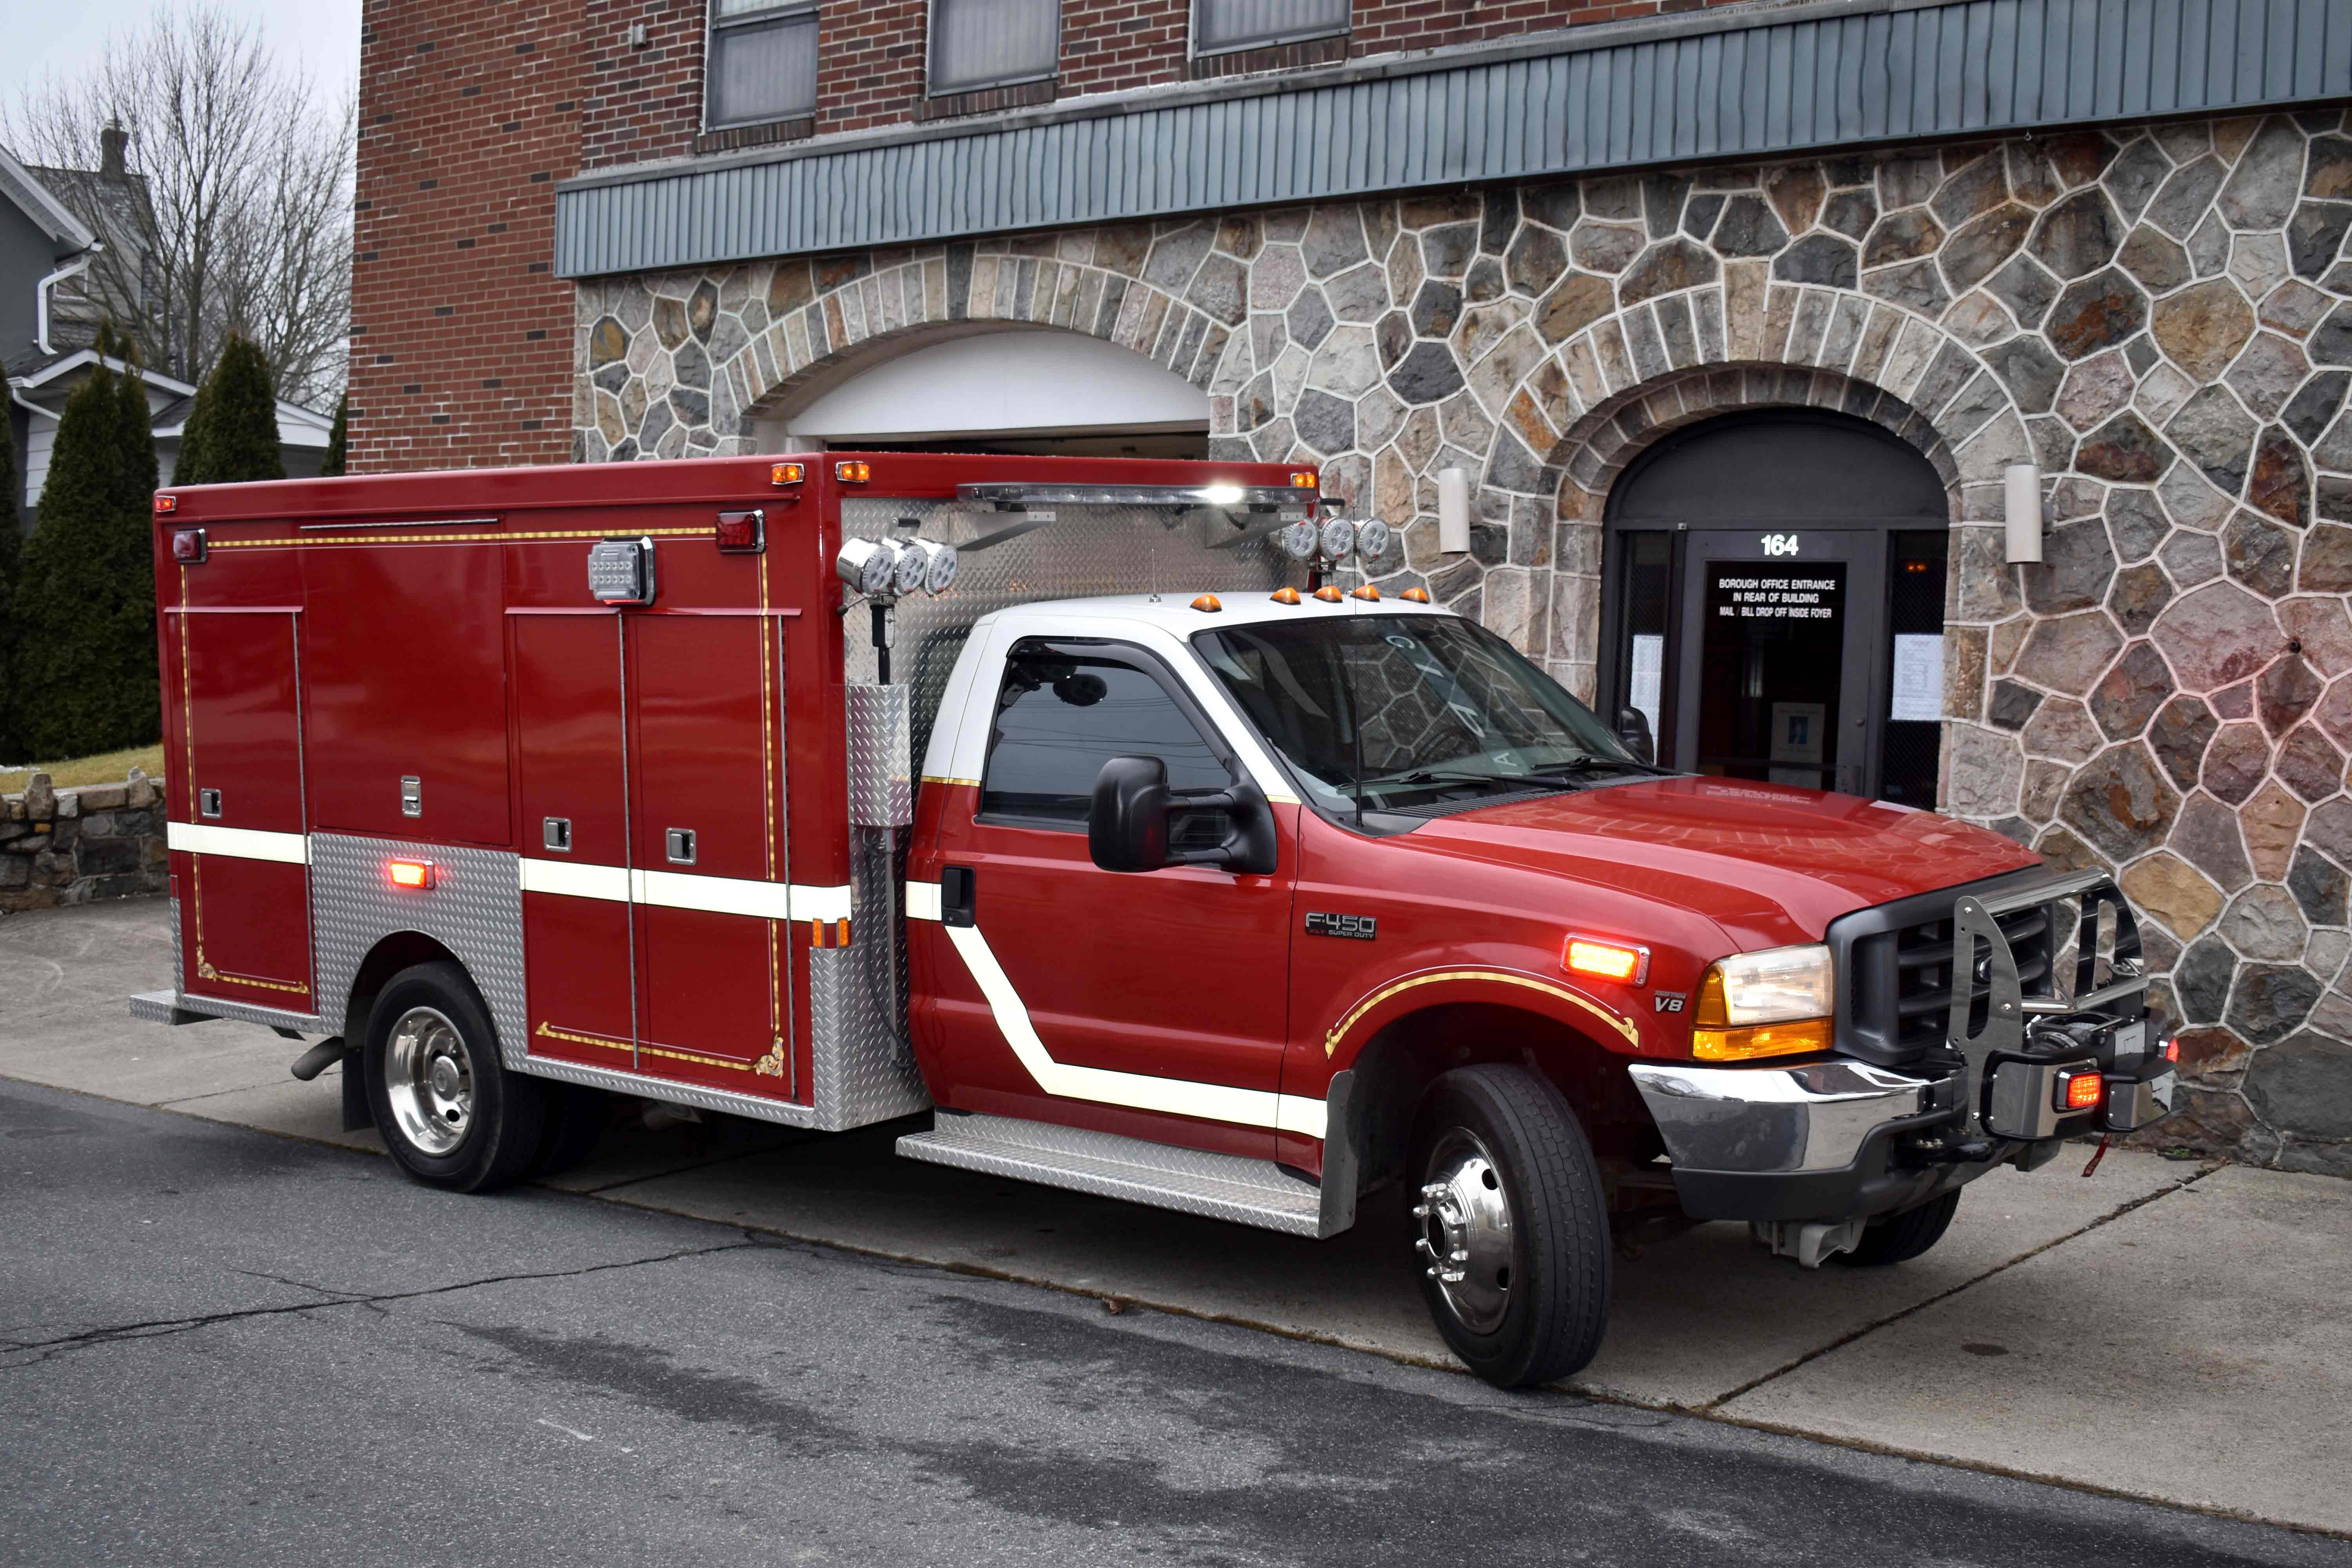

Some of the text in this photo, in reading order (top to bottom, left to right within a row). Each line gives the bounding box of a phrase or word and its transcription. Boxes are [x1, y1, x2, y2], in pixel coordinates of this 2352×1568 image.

[1761, 534, 1799, 556] 164
[1719, 579, 1835, 590] BOROUGH OFFICE ENTRANCE
[1733, 592, 1819, 603] IN REAR OF BUILDING
[1719, 606, 1735, 616] MAIL
[1741, 607, 1755, 617] BILL
[1756, 607, 1774, 617] DROP
[1775, 608, 1787, 617] OFF
[1788, 607, 1809, 618] INSIDE
[1810, 608, 1831, 618] FOYER
[1655, 996, 1683, 1012] V8
